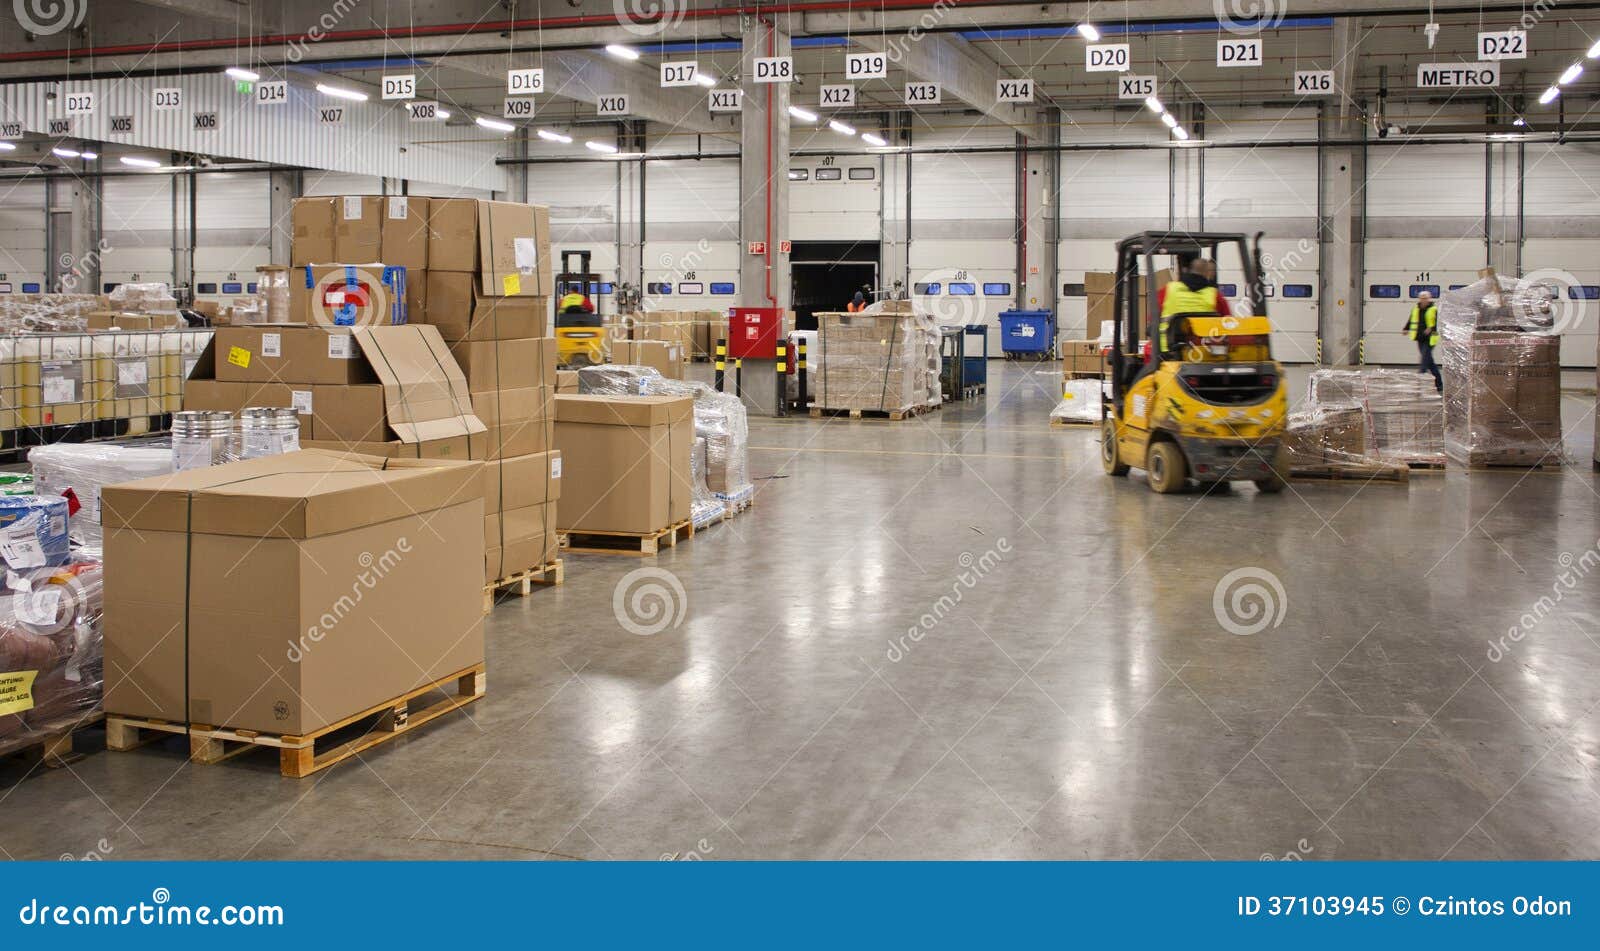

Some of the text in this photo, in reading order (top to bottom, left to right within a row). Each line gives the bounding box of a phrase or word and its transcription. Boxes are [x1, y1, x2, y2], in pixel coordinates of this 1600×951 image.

[1222, 44, 1259, 61] D21
[1483, 36, 1523, 55] D22
[1091, 49, 1126, 66] D20
[758, 61, 790, 78] D18
[850, 57, 884, 74] D19
[512, 74, 541, 89] D16
[664, 66, 695, 82] D17
[1422, 69, 1495, 86] METRO
[385, 79, 413, 95] D15
[1122, 80, 1153, 95] X15
[1298, 74, 1330, 90] X16
[259, 85, 285, 100] D14
[823, 88, 850, 103] X12
[908, 86, 937, 101] X13
[1000, 83, 1029, 98] X14
[68, 96, 91, 111] D12
[155, 91, 180, 106] D13
[600, 98, 626, 111] X10
[711, 93, 738, 107] X11
[320, 108, 343, 122] X07
[411, 104, 435, 118] X08
[506, 101, 531, 114] X09
[50, 121, 69, 134] X04
[112, 118, 132, 131] X05
[194, 114, 216, 128] X06
[2, 123, 21, 137] X03
